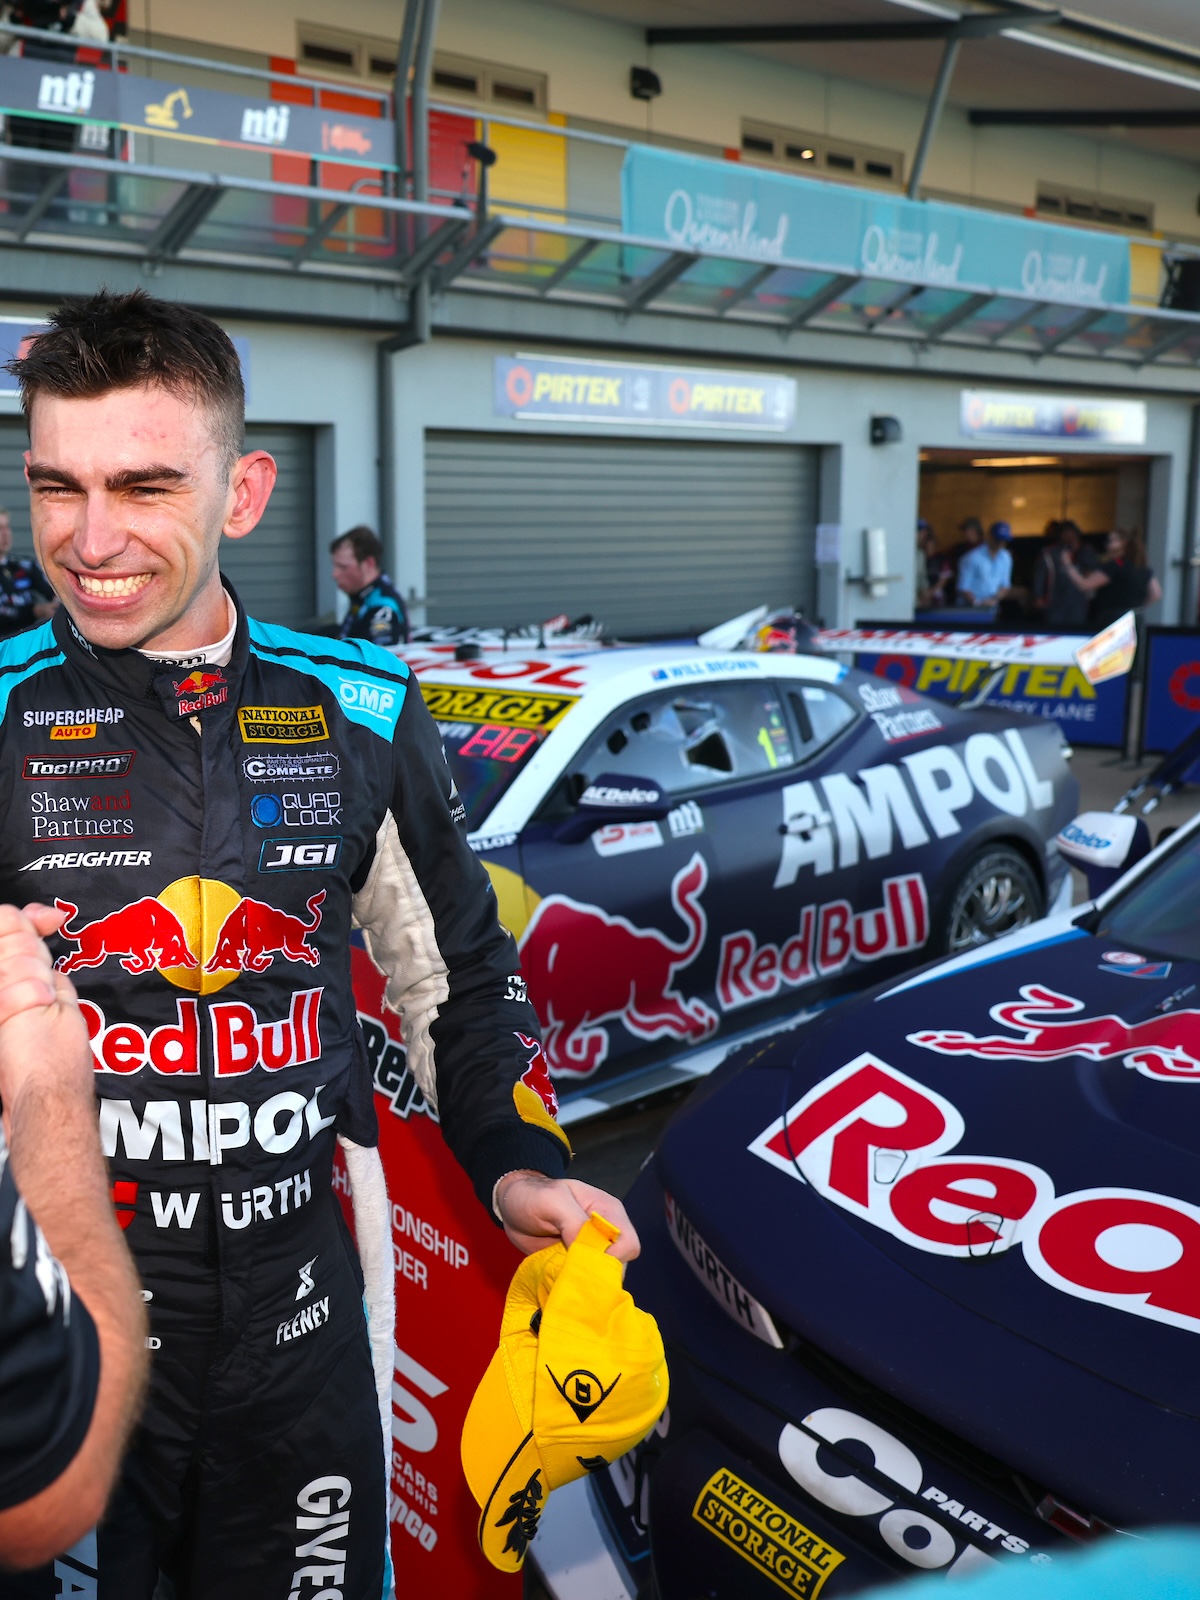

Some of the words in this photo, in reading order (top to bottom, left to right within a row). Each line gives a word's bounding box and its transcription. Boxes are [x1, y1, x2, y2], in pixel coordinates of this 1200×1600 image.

[40, 71, 95, 110] nti
[242, 104, 289, 144] nti
[533, 371, 622, 406] PIRTEK
[690, 383, 766, 415] PIRTEK
[915, 656, 1097, 700] PITEK
[179, 694, 203, 716] Red
[204, 687, 229, 707] Bull
[241, 709, 321, 723] NATIONAL
[339, 682, 395, 714] OMP
[420, 688, 562, 724] ORAGE
[23, 707, 125, 728] SUPERCHEAP
[54, 727, 92, 738] AUTO
[249, 724, 321, 738] STORAGE
[30, 791, 91, 813] Shaw
[91, 789, 132, 811] and
[282, 791, 342, 810] QUAD
[283, 808, 343, 827] LOCK
[773, 727, 1055, 890] AMPOL
[31, 816, 135, 839] Partners
[18, 850, 153, 872] FREIGHTER
[266, 843, 338, 868] JGI
[716, 903, 817, 1012] Red
[815, 873, 930, 977] Bull
[209, 986, 325, 1079] Bull
[355, 1009, 440, 1124] Rep
[98, 1086, 338, 1166] MPOL
[275, 1295, 330, 1346] FEENEY
[711, 1472, 833, 1572] NATIONAL
[921, 1485, 1031, 1555] PARTS
[703, 1498, 814, 1595] STORAGE
